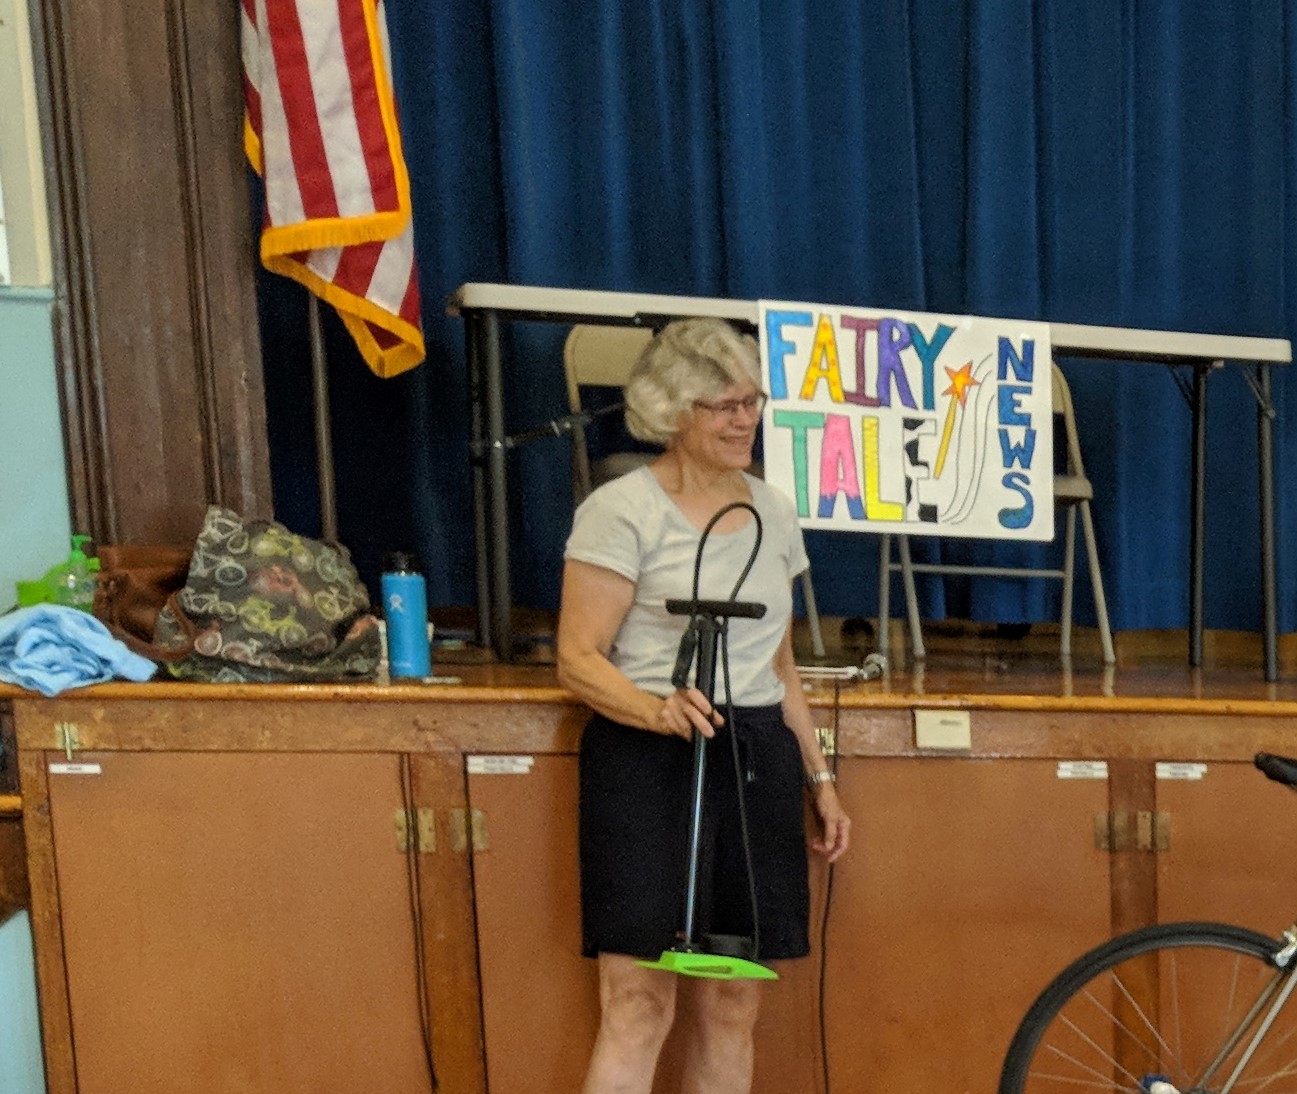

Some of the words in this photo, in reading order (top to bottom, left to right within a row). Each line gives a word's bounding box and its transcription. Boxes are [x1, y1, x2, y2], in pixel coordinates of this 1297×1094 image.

[765, 309, 957, 411] FAIRY
[773, 409, 938, 524] TALE
[997, 335, 1036, 529] NEWS
